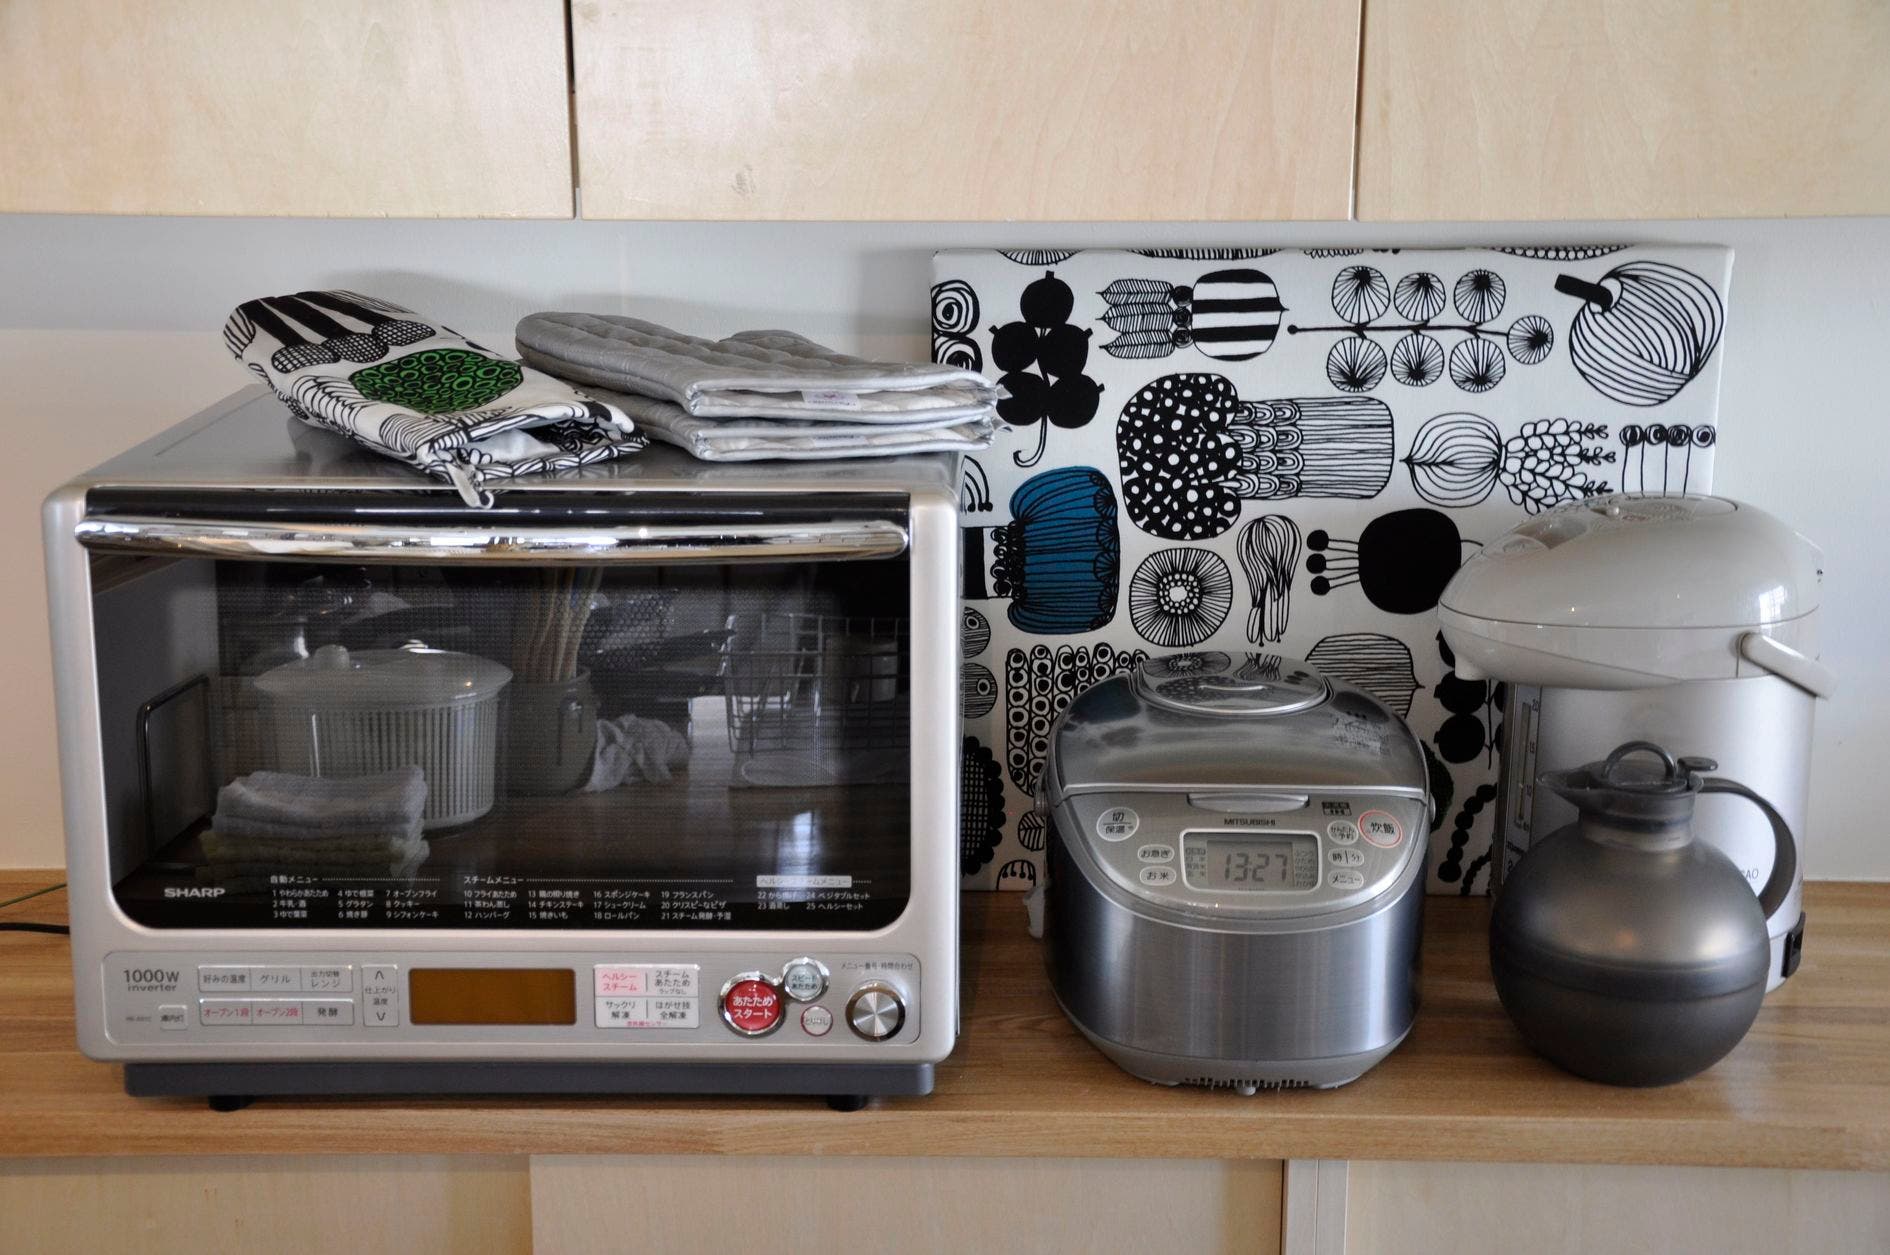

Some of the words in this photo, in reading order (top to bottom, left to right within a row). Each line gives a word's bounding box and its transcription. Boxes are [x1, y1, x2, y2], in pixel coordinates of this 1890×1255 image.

[1112, 812, 1125, 822] 切
[1224, 818, 1276, 826] MITSUBISHI
[1105, 825, 1126, 834] 保温
[1370, 821, 1395, 835] 炊飯
[270, 875, 318, 884] 自動メニュー
[463, 875, 524, 885] スチームメニュー
[1332, 873, 1361, 885] メニュー
[163, 887, 226, 898] SHARP
[272, 889, 277, 897] 1
[337, 889, 343, 898] 4
[385, 889, 391, 898] 7
[393, 888, 438, 898] オーブンフライ
[463, 890, 473, 898] 10
[474, 889, 518, 899] フライあたため
[528, 890, 537, 899] 13
[593, 890, 602, 899] 16
[604, 889, 650, 899] スポンジケーキ
[661, 890, 670, 899] 19
[672, 889, 714, 899] フランスパン
[757, 891, 767, 900] 22
[806, 892, 816, 900] 24
[272, 900, 278, 908] 2
[338, 900, 344, 908] 5
[345, 900, 374, 909] グラタン
[385, 900, 391, 908] 8
[393, 900, 420, 909] クッキー
[463, 900, 473, 908] 11
[528, 901, 537, 909] 14
[539, 901, 584, 910] チキンステーキ
[593, 901, 602, 909] 17
[604, 900, 647, 910] シュークリーム
[661, 901, 670, 910] 20
[672, 900, 728, 910] クリスピーなピザ
[757, 902, 767, 911] 23
[806, 903, 816, 911] 25
[818, 903, 863, 911] ヘルシーセット
[273, 910, 279, 919] 3
[338, 911, 344, 919] 6
[385, 911, 392, 919] 9
[393, 911, 440, 919] シフォンケーキ
[464, 911, 473, 919] 12
[474, 911, 512, 920] ハンバーグ
[528, 911, 537, 920] 15
[593, 911, 602, 920] 18
[604, 911, 640, 920] ロールパン
[661, 911, 670, 921] 21
[123, 968, 180, 983] 1000W
[602, 972, 638, 982] ヘルシー
[655, 969, 690, 979] スチーム
[260, 974, 291, 985] グリル
[311, 978, 340, 989] レンジ
[654, 978, 691, 988] あたため
[603, 982, 638, 992] スチーム
[733, 995, 774, 1008] あたため
[734, 1008, 773, 1020] スタート
